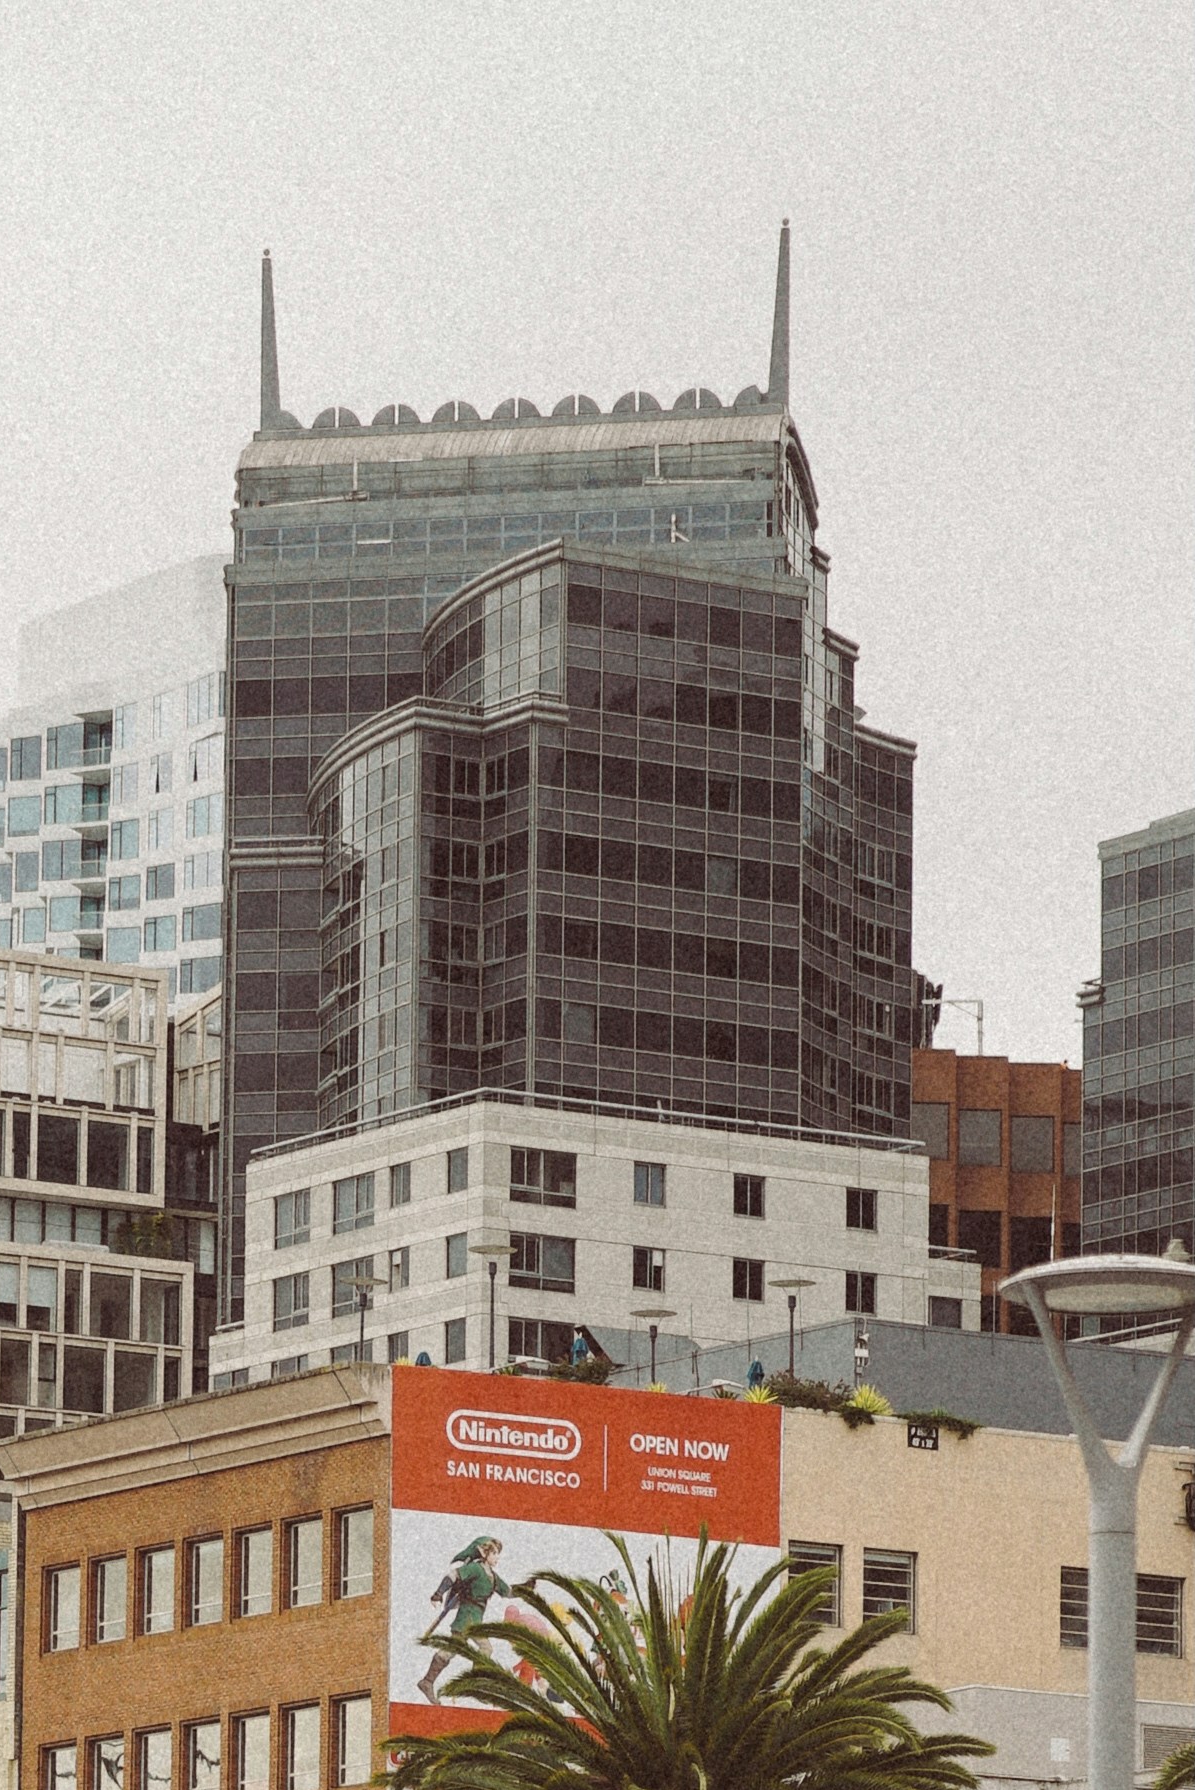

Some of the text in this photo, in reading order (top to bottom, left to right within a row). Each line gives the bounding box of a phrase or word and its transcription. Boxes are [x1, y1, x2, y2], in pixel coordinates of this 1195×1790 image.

[459, 1419, 570, 1451] Nintendo
[629, 1432, 730, 1462] OPEN NOW
[446, 1460, 581, 1489] SAN FRANCISCO
[640, 1480, 718, 1497] 331 POWELL STREET
[647, 1466, 711, 1482] UNION SQUARE
